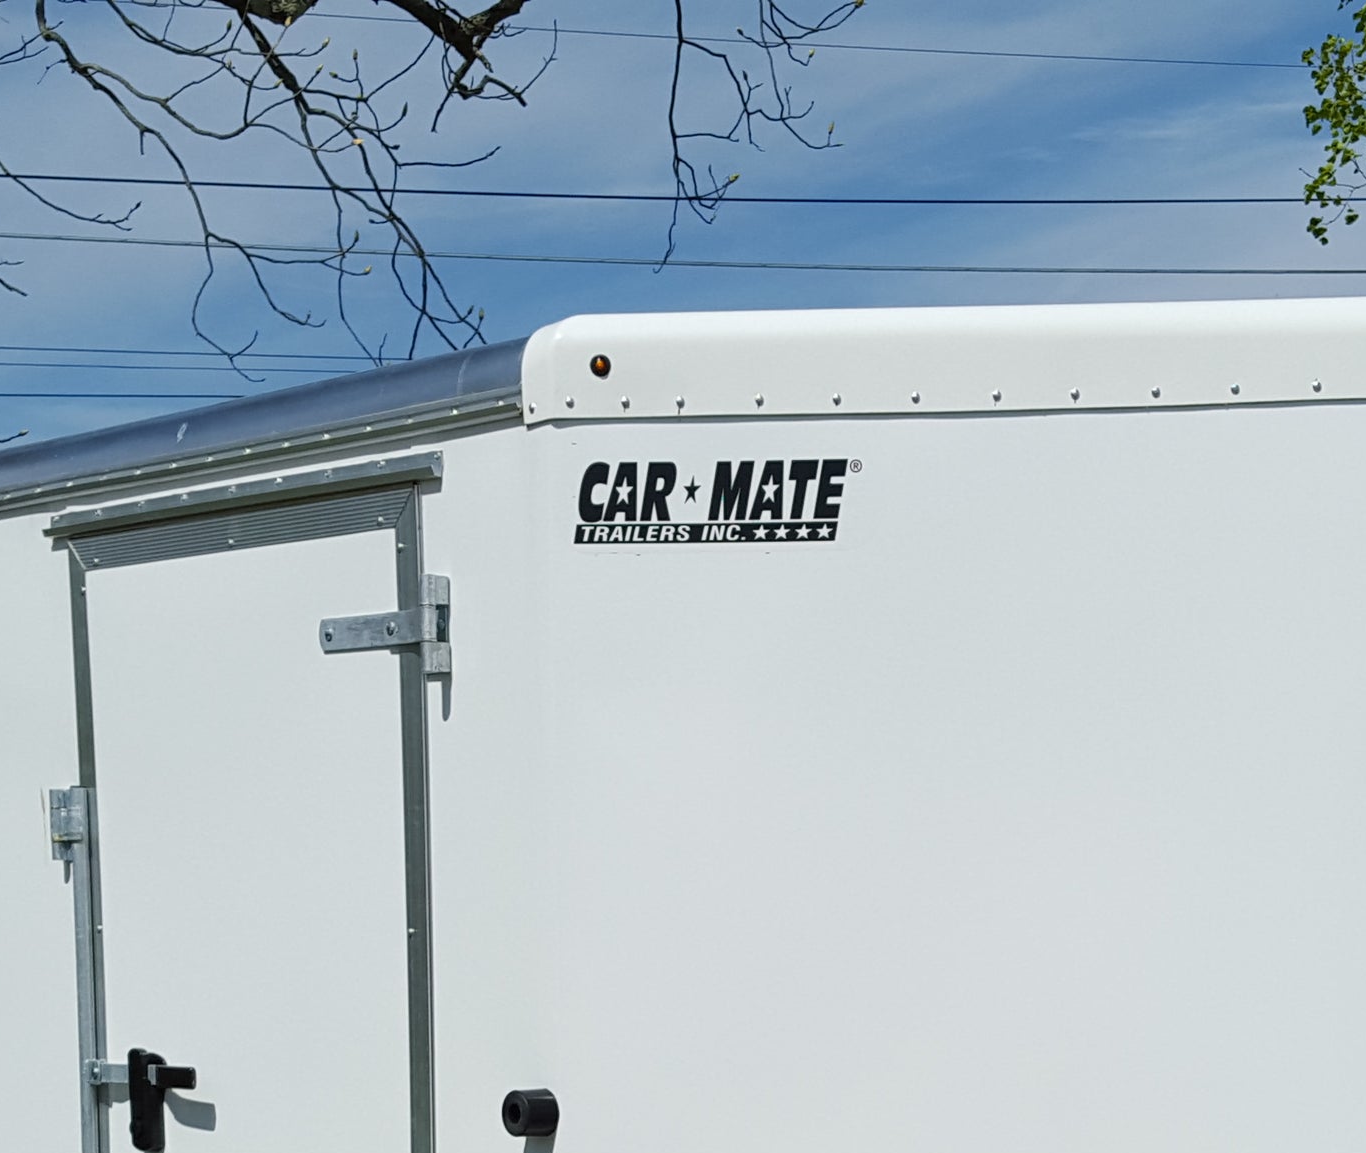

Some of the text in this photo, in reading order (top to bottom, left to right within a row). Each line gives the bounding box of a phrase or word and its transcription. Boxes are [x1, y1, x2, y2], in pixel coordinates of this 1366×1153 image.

[578, 458, 849, 523] CAR MATE
[580, 524, 747, 542] TRAILERS INC.
